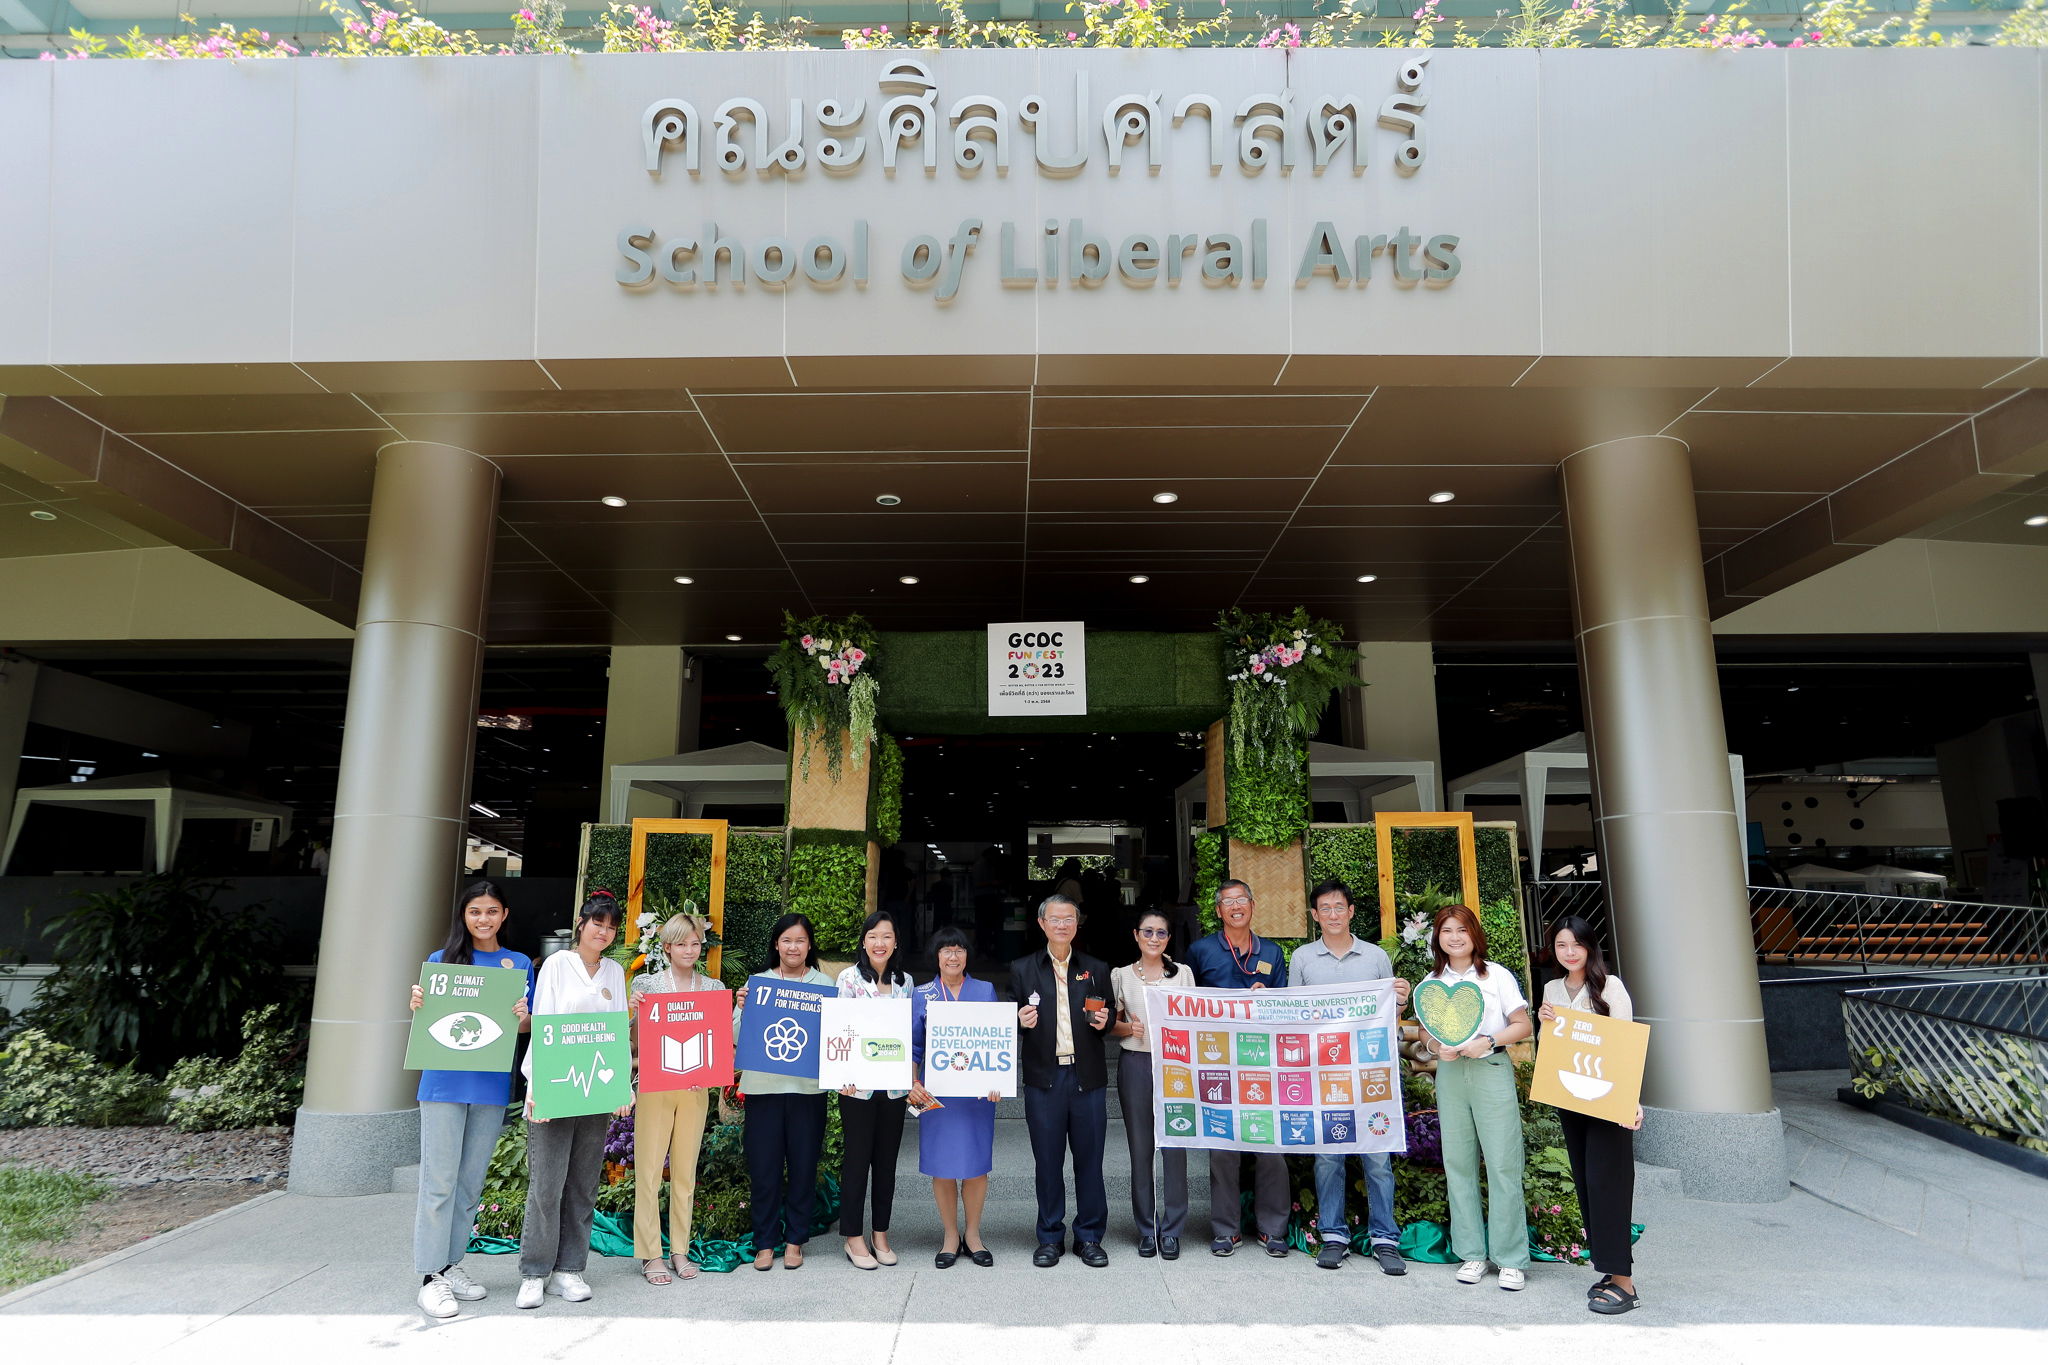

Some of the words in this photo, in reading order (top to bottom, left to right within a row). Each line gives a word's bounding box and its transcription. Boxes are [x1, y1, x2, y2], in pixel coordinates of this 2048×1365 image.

[641, 50, 1432, 176] คณะศิลปศาสตร์
[615, 219, 868, 287] School
[901, 218, 983, 301] of
[1000, 218, 1267, 285] Liberal
[1295, 221, 1462, 286] Arts
[1008, 632, 1064, 648] GCDC
[1008, 652, 1032, 660] FUN
[1036, 650, 1064, 660] FEST
[1008, 662, 1064, 679] 2023
[429, 973, 448, 996] 13
[454, 974, 486, 986] CLIMATE
[452, 986, 480, 998] ACTION
[756, 986, 772, 1006] 17
[776, 988, 824, 1002] PARTNERSHIPS
[667, 1000, 695, 1012] QUALITY
[774, 998, 787, 1009] FOR
[788, 1000, 800, 1010] THE
[800, 1002, 822, 1013] GOALS
[1168, 994, 1253, 1020] KMUTT
[1256, 1000, 1310, 1008] SUSTAINABLE
[1312, 996, 1358, 1007] UNIVERSITY
[1362, 994, 1378, 1004] FOR
[650, 1002, 660, 1022] 4
[667, 1011, 704, 1022] EDUCATION
[1300, 1008, 1345, 1020] GOALS
[1348, 1004, 1377, 1017] 2030
[561, 1023, 580, 1033] GOOD
[581, 1022, 606, 1032] HEALTH
[932, 1026, 1012, 1038] SUSTAINABLE
[1553, 1016, 1566, 1037] 2
[1572, 1019, 1593, 1032] ZERO
[544, 1024, 554, 1046] 3
[561, 1035, 576, 1045] AND
[577, 1032, 616, 1044] WELL-BEING
[1200, 1033, 1203, 1041] 2
[1571, 1030, 1602, 1046] HUNGER
[827, 1037, 851, 1049] KM
[932, 1039, 1012, 1050] DEVELOPMENT
[931, 1050, 1012, 1072] GOALS
[1362, 1071, 1368, 1079] 12
[1166, 1105, 1173, 1113] 13
